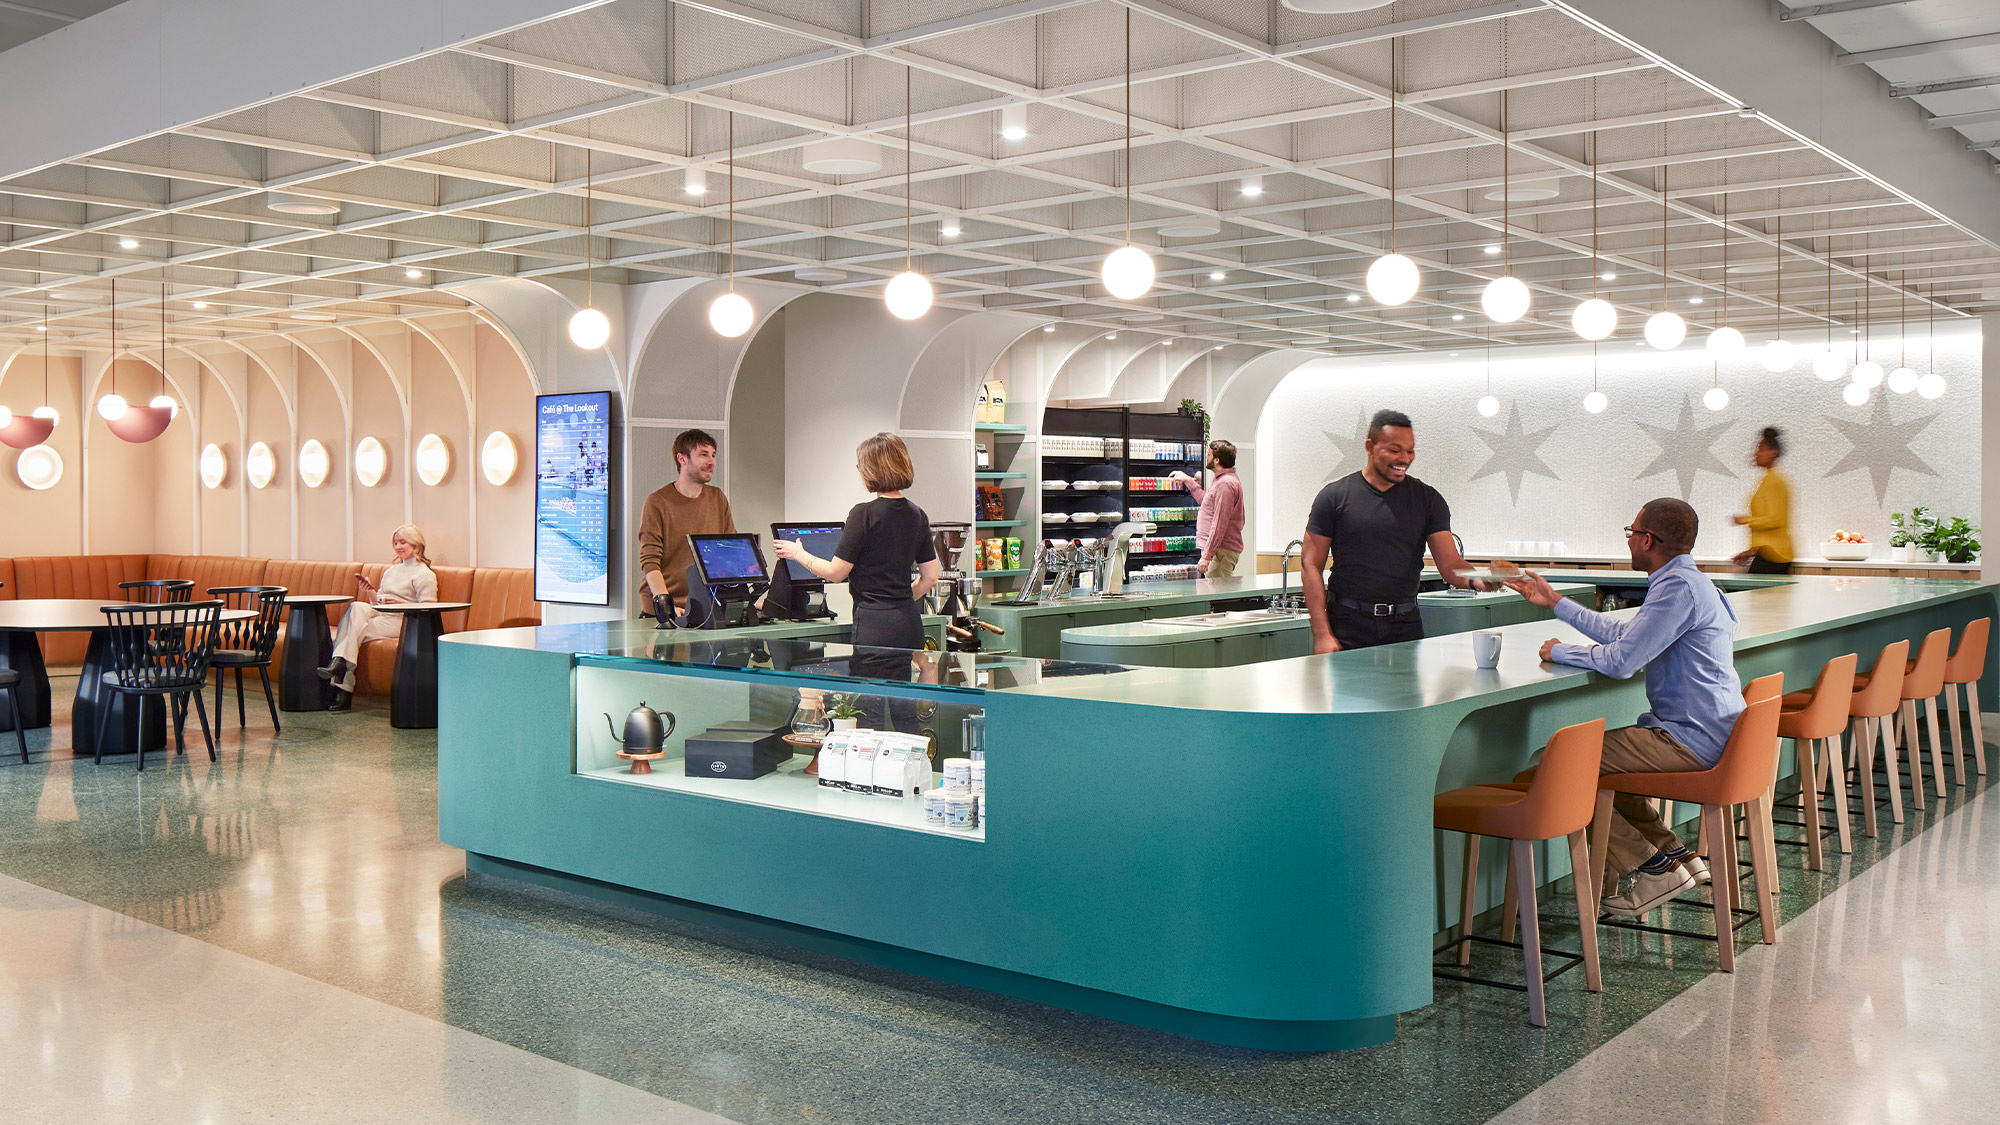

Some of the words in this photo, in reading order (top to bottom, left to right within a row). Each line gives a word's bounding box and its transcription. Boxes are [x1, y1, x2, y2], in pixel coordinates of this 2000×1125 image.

[542, 405, 555, 414] Café
[556, 405, 562, 414] @
[563, 404, 574, 413] The
[574, 403, 598, 412] Lookout
